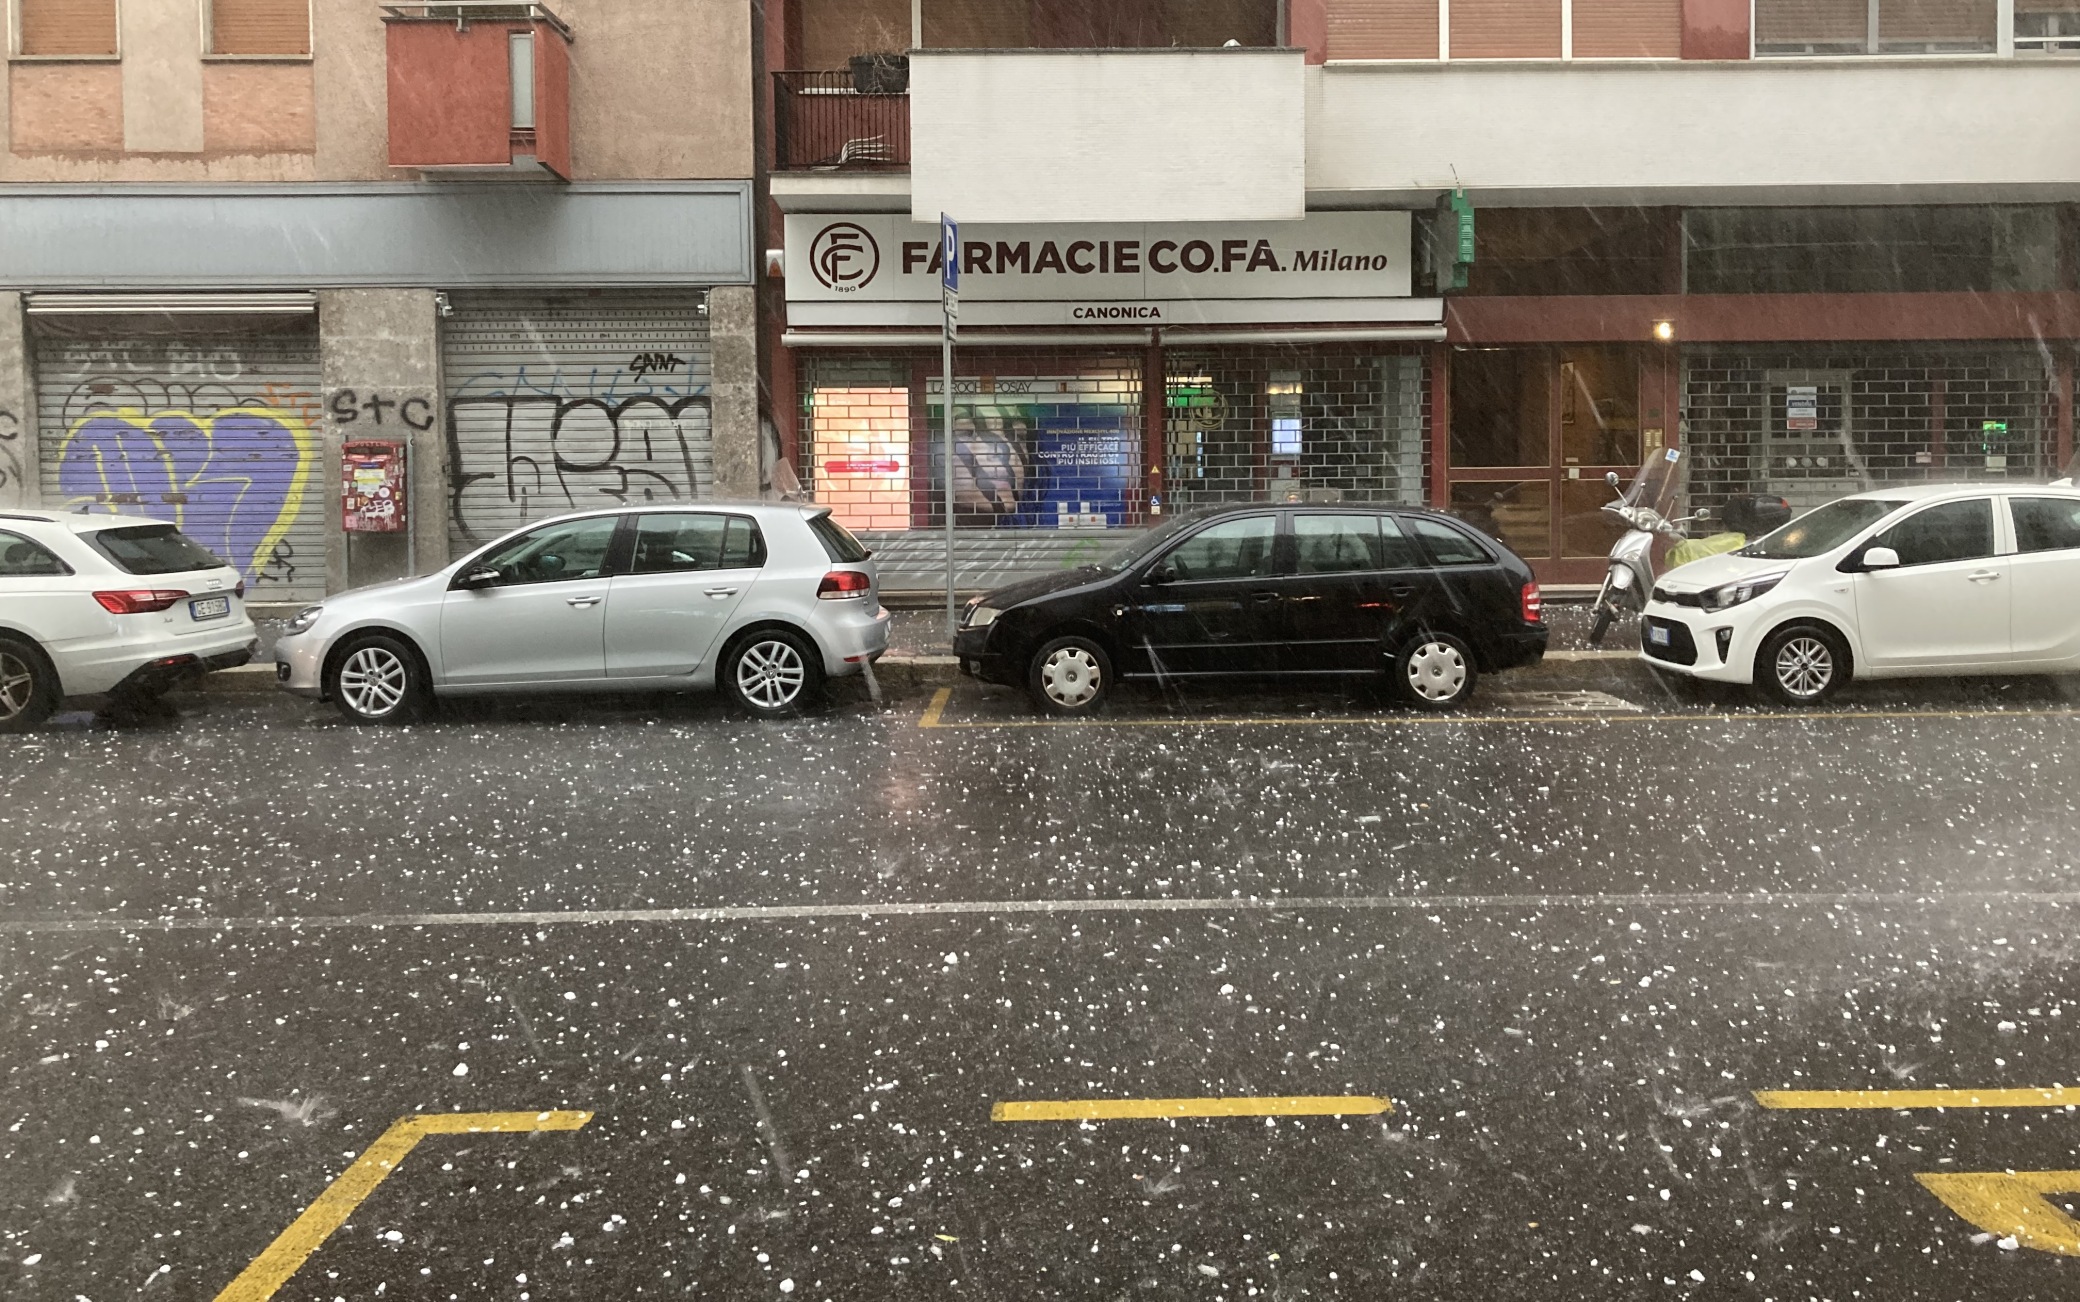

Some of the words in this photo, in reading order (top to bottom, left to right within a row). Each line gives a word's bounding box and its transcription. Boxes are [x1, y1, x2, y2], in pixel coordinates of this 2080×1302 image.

[946, 224, 955, 279] P
[1292, 249, 1388, 272] Milano
[834, 285, 856, 293] 1890
[1072, 306, 1161, 319] CANONICA
